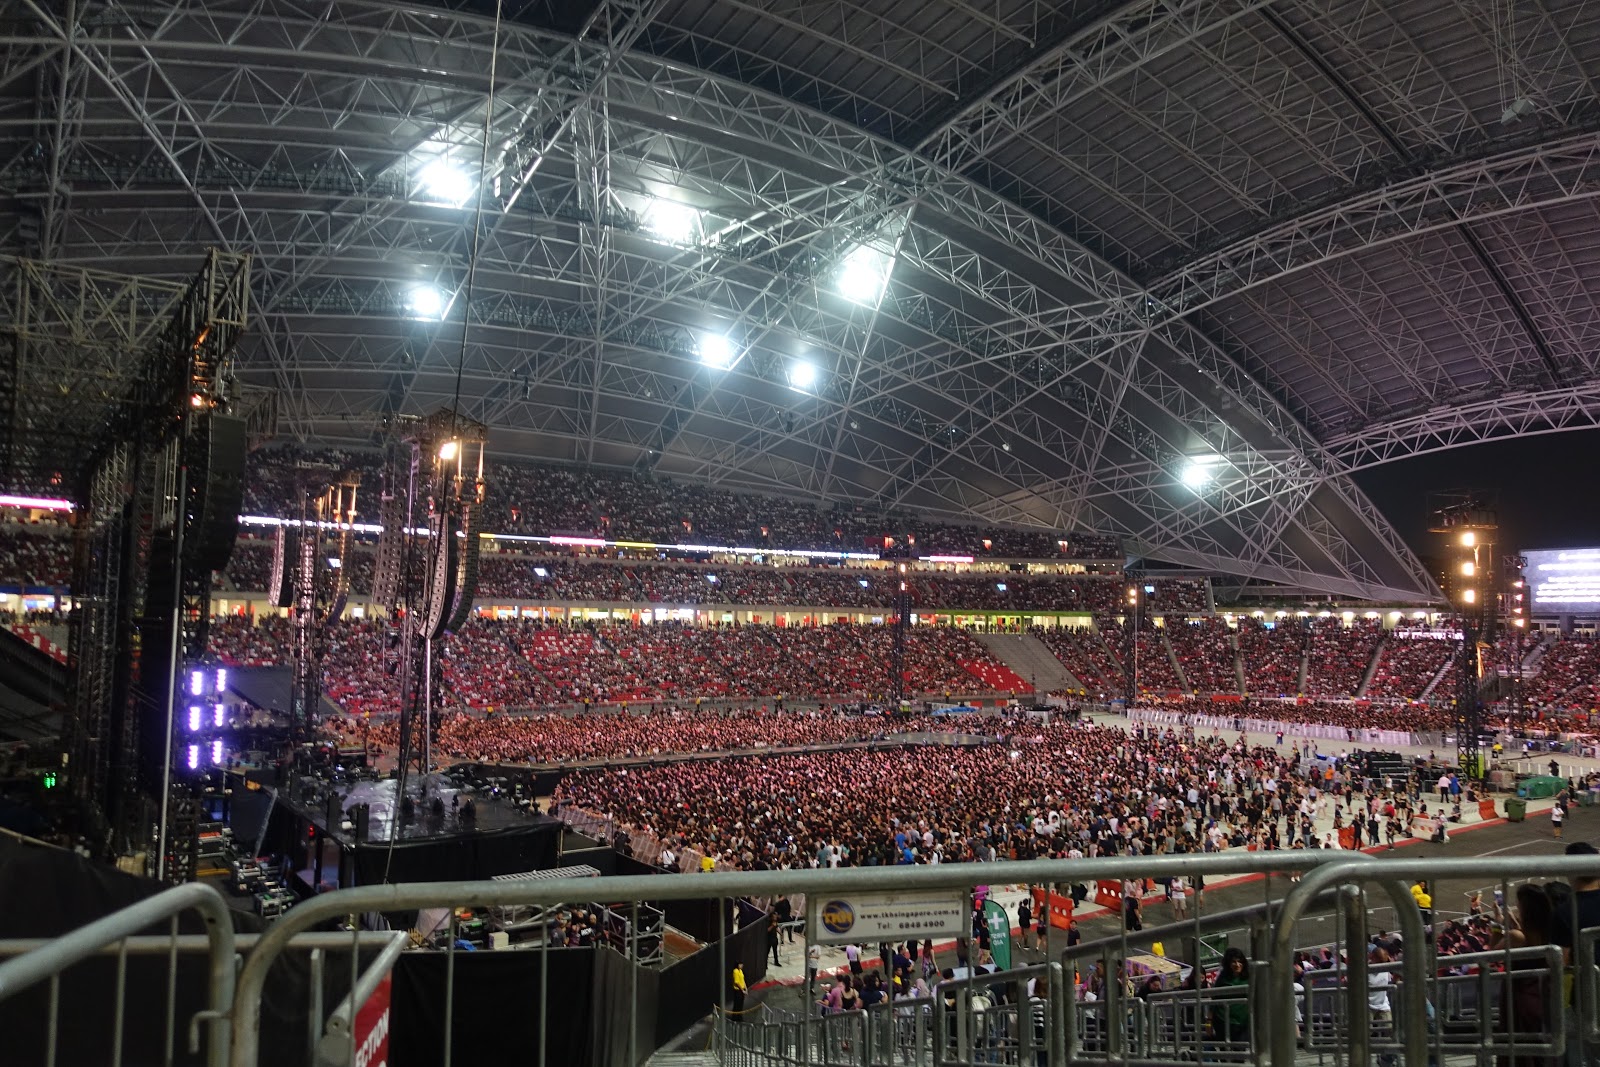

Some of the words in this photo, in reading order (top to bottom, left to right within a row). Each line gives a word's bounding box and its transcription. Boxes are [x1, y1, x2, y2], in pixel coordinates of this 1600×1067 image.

[860, 909, 960, 919] www.tkhsingapore.com.sg
[877, 922, 892, 930] Tel:
[898, 921, 921, 930] 6848
[923, 920, 945, 928] 4900
